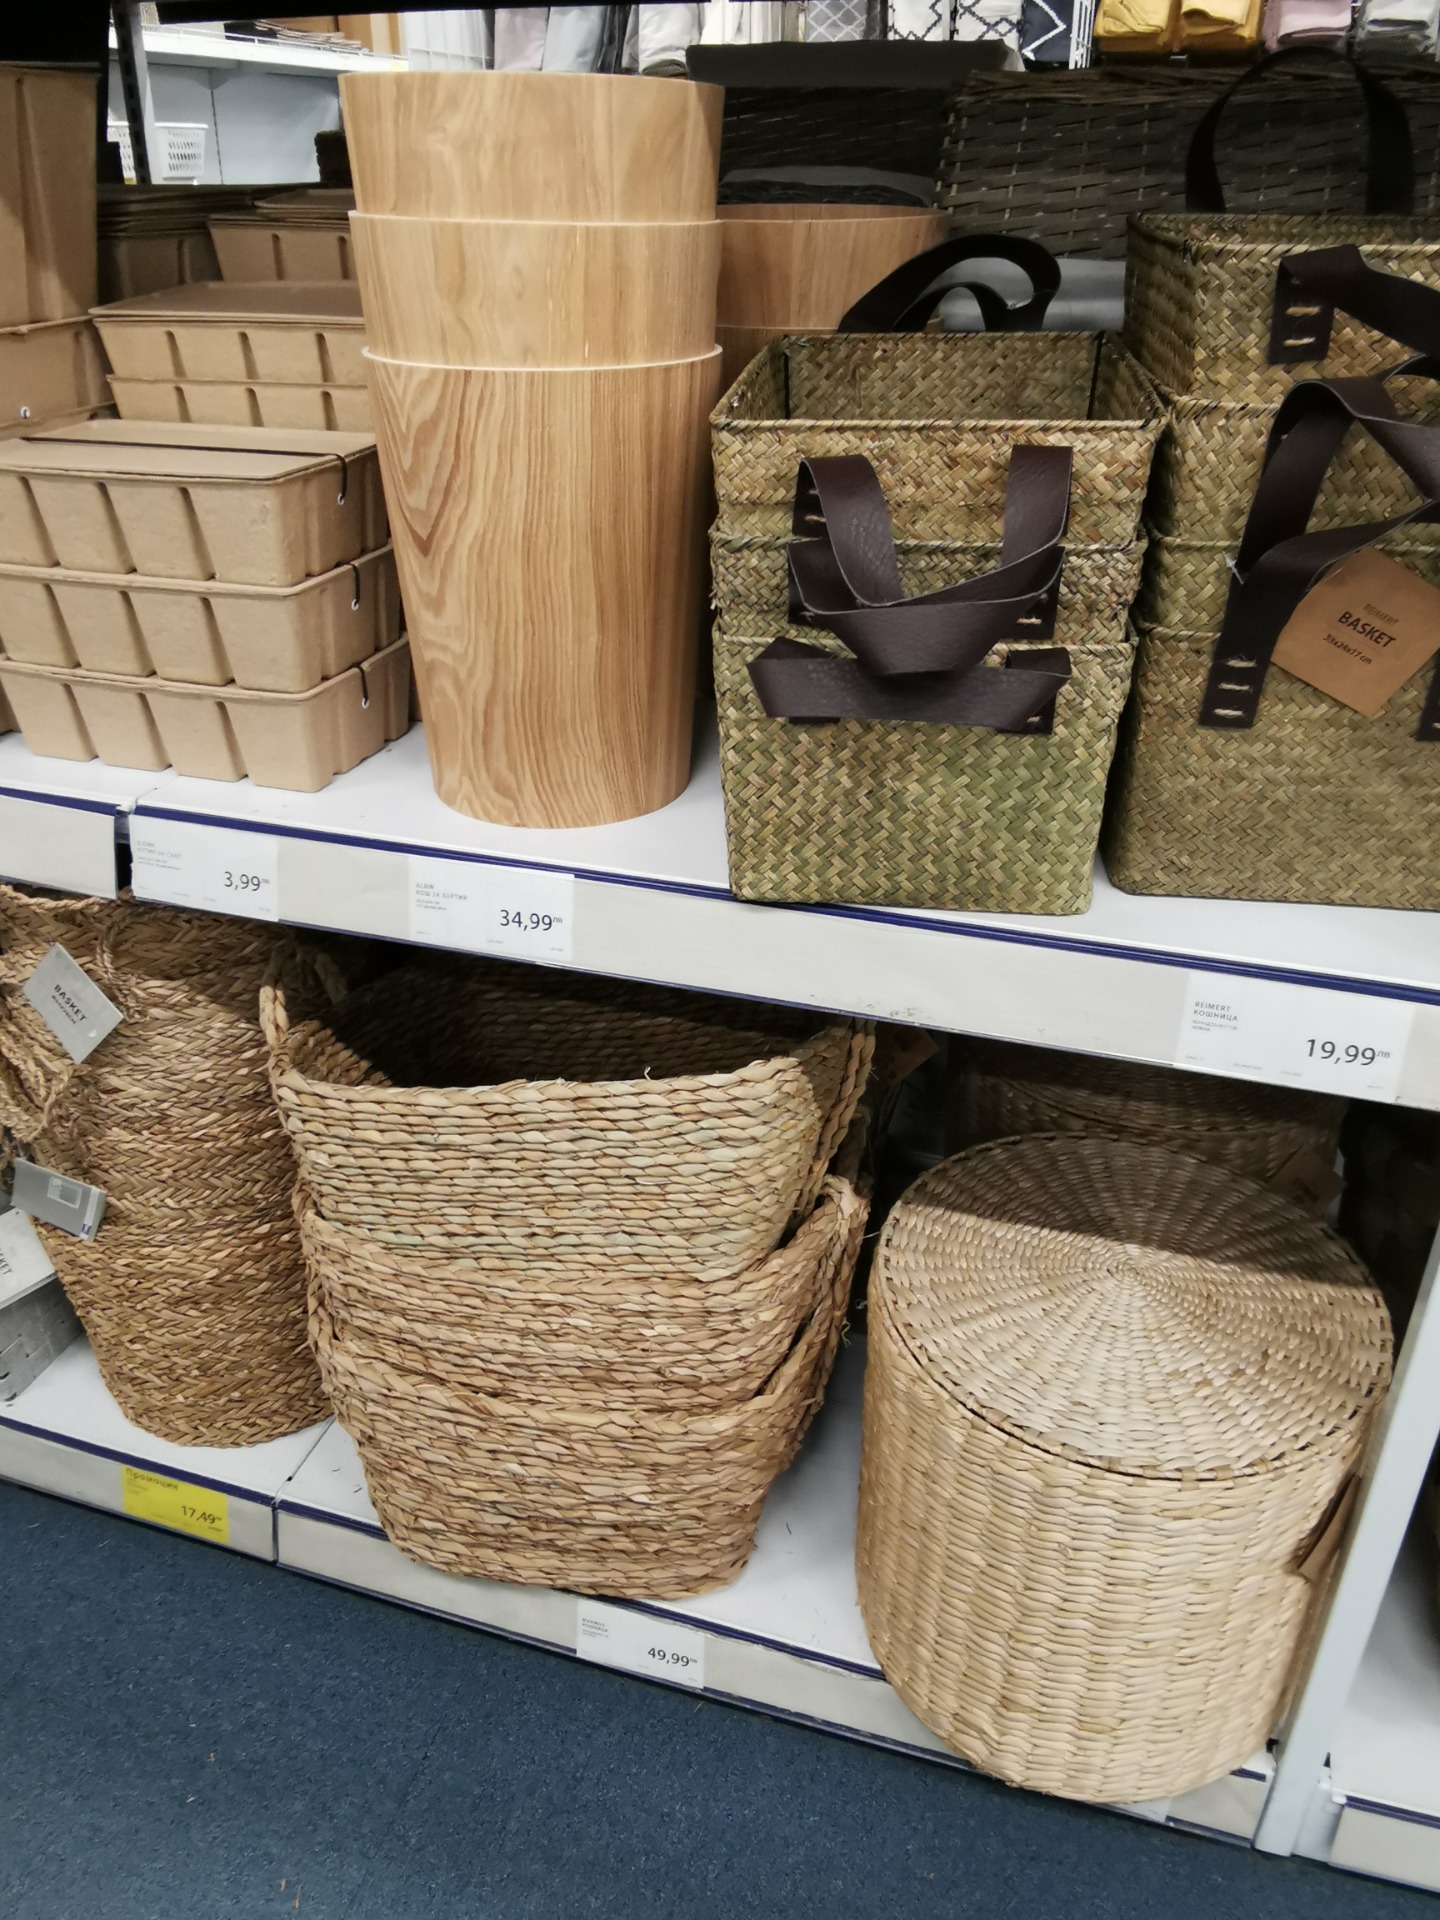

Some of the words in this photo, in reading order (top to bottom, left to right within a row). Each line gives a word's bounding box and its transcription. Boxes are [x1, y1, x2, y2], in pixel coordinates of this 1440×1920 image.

[1337, 611, 1397, 648] BASKET
[224, 871, 261, 891] 3,99
[500, 909, 553, 932] 34,99
[53, 984, 87, 1022] BASKET
[1195, 1001, 1231, 1012] REIMERT
[1193, 1009, 1238, 1022] КОШНИЦА
[1307, 1038, 1376, 1066] 19,99
[647, 1647, 690, 1667] 49,99
